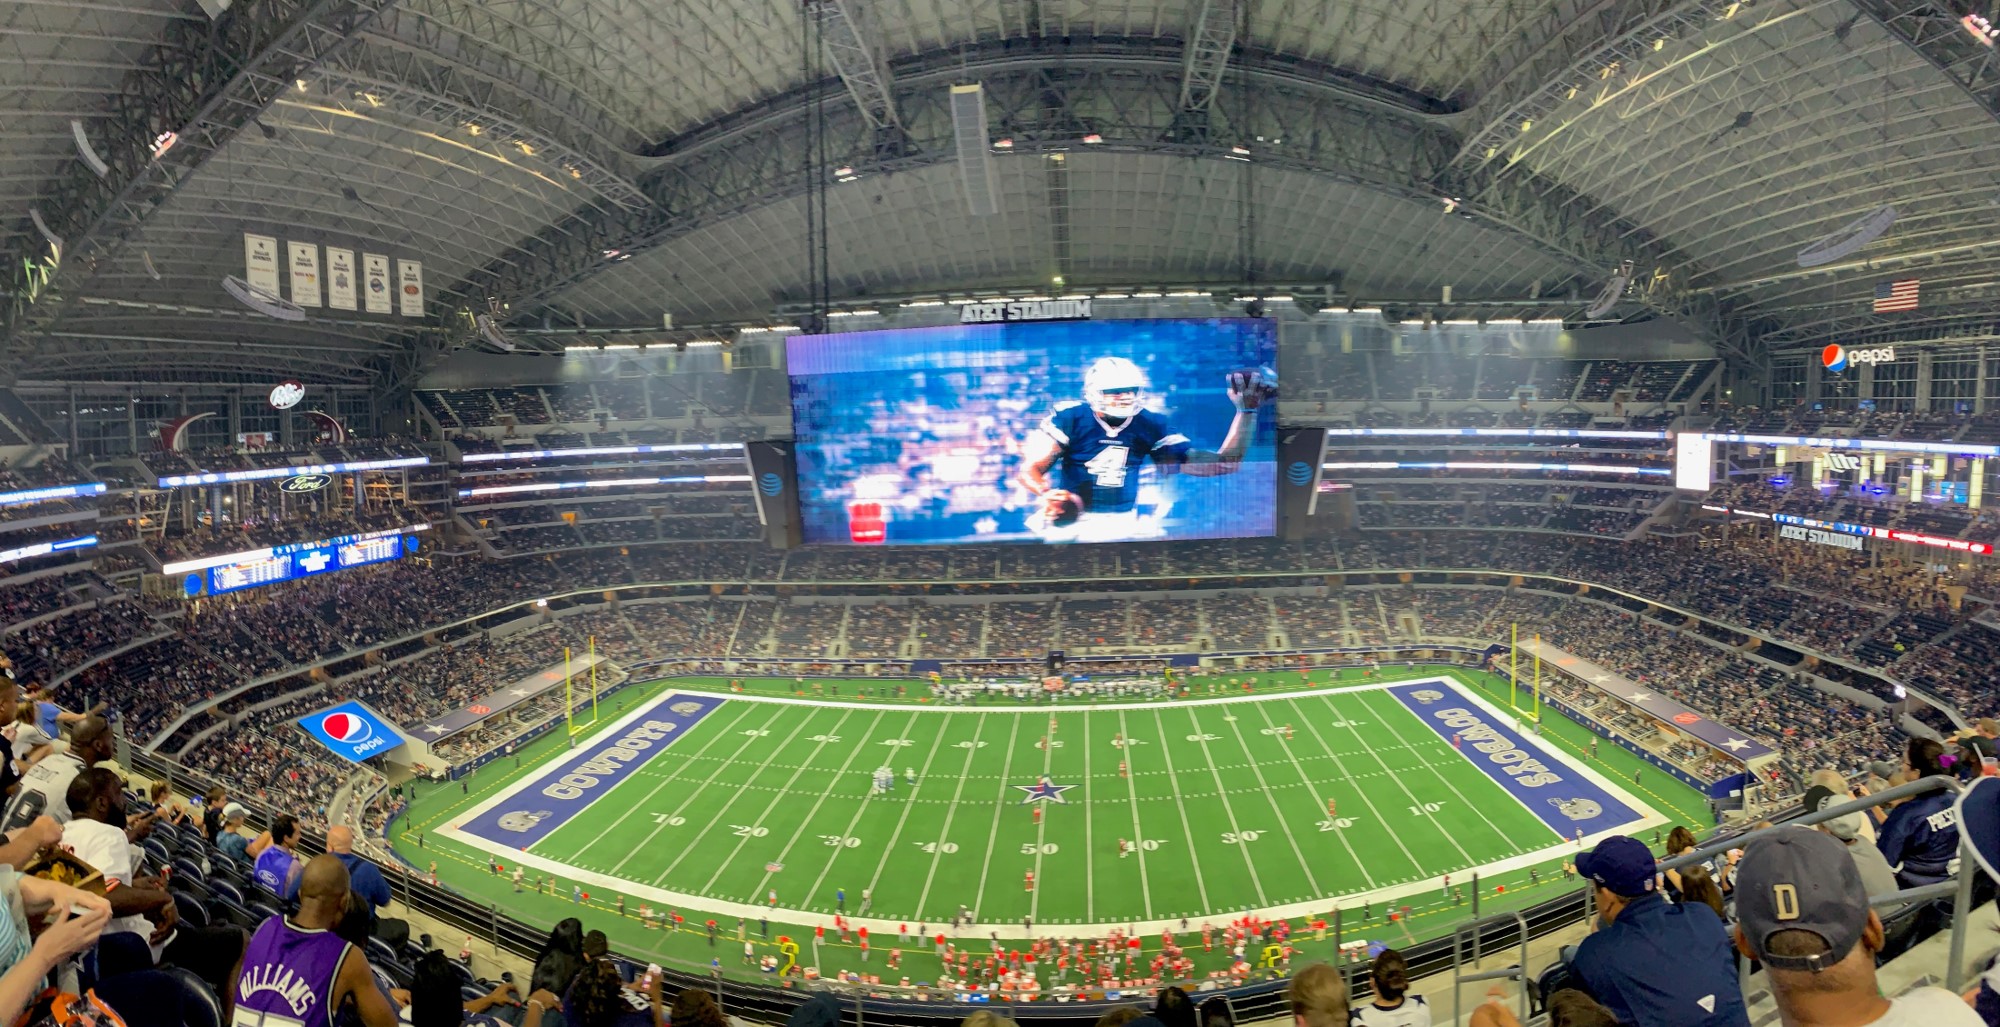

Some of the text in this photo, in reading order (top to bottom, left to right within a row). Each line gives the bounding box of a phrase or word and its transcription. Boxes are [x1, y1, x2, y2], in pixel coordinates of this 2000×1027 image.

[960, 300, 1092, 323] AT&T STADIUM
[1848, 345, 1896, 368] pepsi
[1084, 445, 1130, 488] 4
[289, 475, 324, 490] Ford
[1780, 524, 1809, 540] AT&T
[1808, 529, 1864, 551] STADIUM
[353, 735, 385, 756] pepsi
[1434, 708, 1564, 788] COWBOYS
[542, 720, 677, 800] COWBOYS
[1407, 802, 1440, 817] 10
[653, 813, 686, 826] 10
[1315, 818, 1352, 832] 20
[732, 825, 769, 837] 20
[1221, 830, 1259, 844] 30
[824, 835, 861, 848] 30
[921, 842, 959, 854] 40
[1020, 843, 1059, 855] 50
[1772, 884, 1800, 920] D
[240, 962, 317, 1017] WILLIAMS
